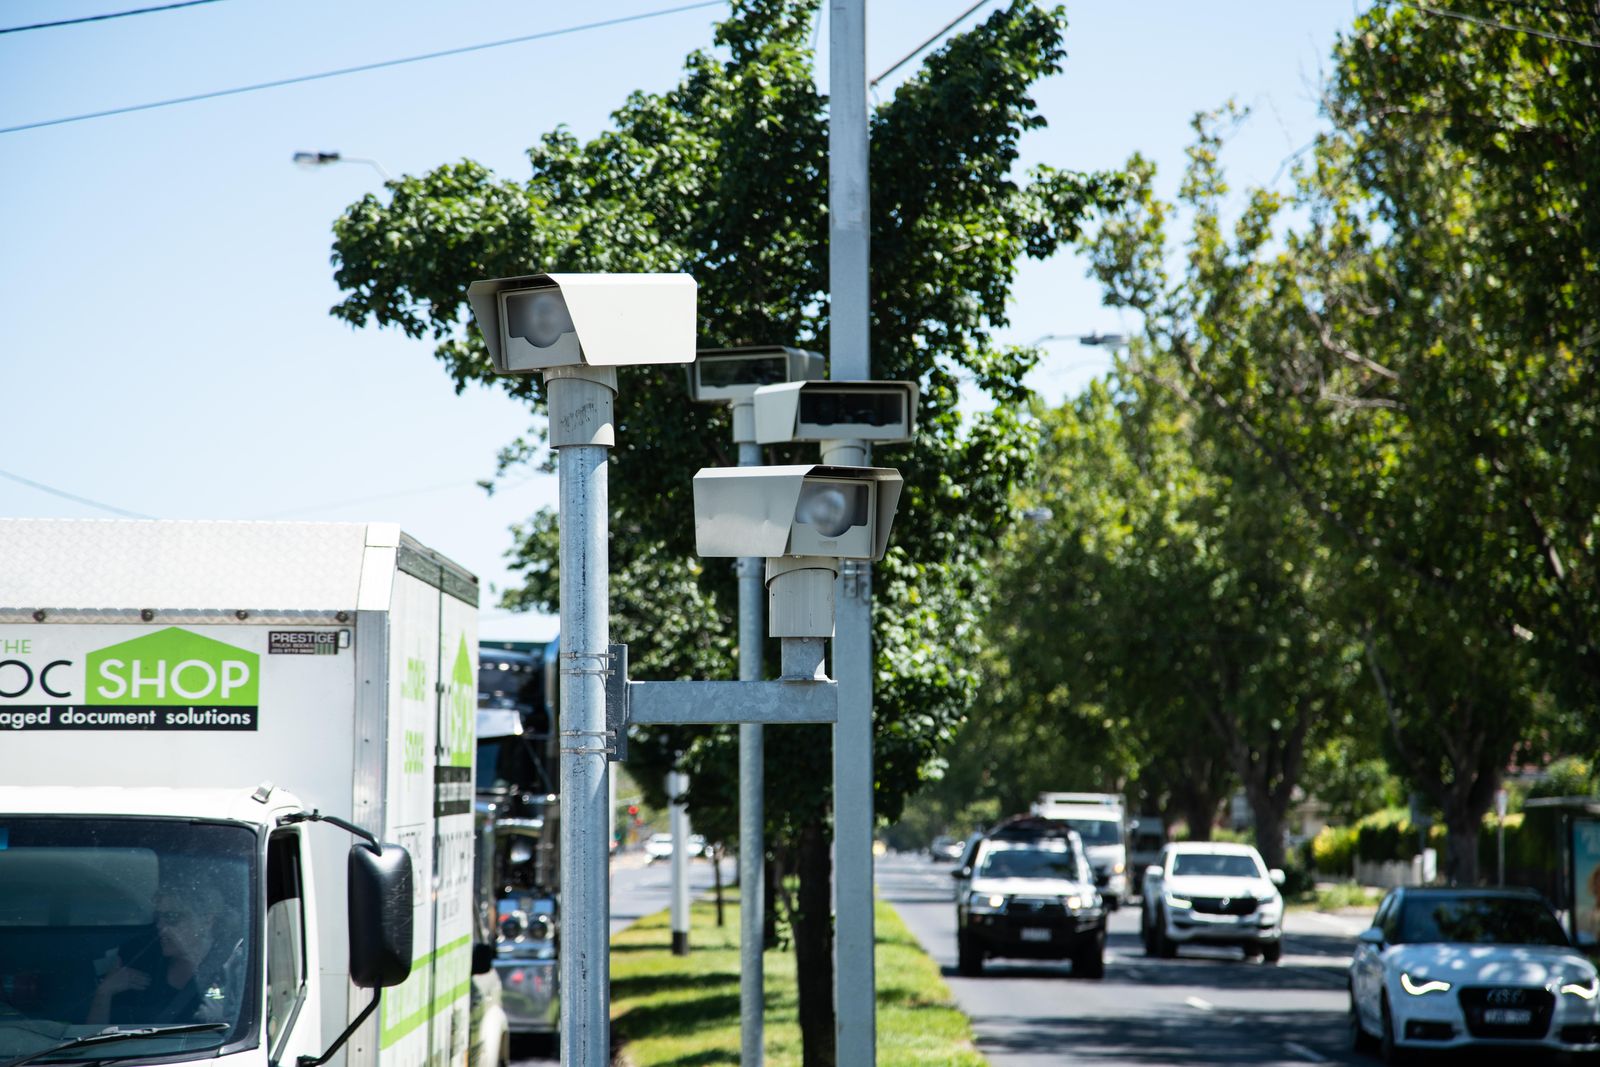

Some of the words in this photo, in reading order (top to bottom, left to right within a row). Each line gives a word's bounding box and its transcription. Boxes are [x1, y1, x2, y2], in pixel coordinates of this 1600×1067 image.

[0, 639, 32, 654] HE
[271, 633, 336, 643] PRESTIGE
[97, 658, 250, 699] SHOP
[60, 707, 157, 725] document
[166, 706, 251, 725] solutions
